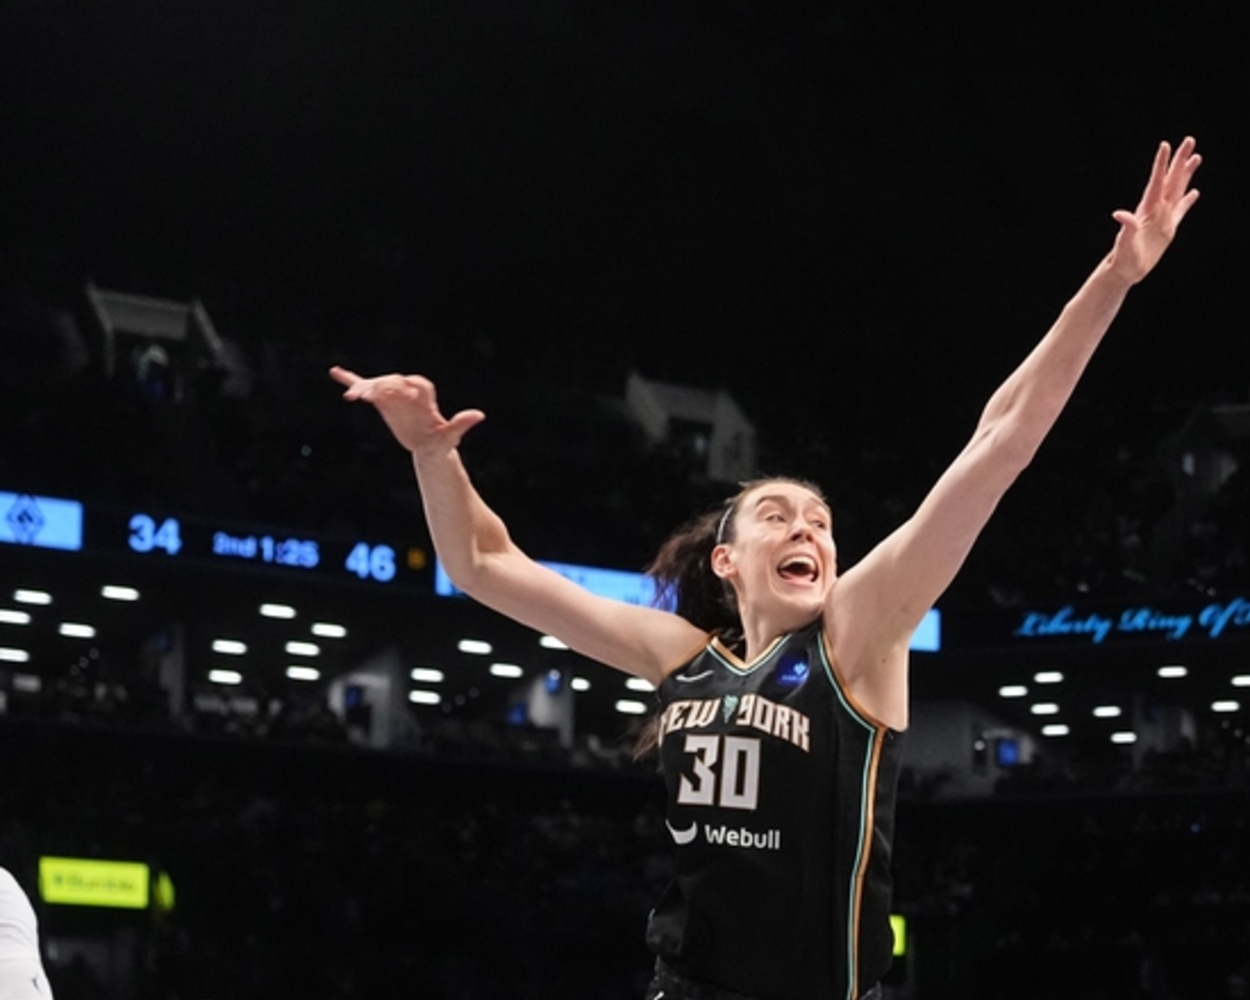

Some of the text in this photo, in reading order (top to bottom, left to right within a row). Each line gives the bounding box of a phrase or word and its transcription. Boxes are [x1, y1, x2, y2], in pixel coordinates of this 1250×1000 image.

[129, 514, 182, 554] 34
[259, 536, 320, 568] 1:25
[345, 542, 397, 582] 46
[1016, 606, 1111, 643] Liberty
[1118, 607, 1192, 640] Ring
[736, 694, 810, 753] YORK
[677, 734, 761, 810] 30
[704, 824, 781, 849] Webull
